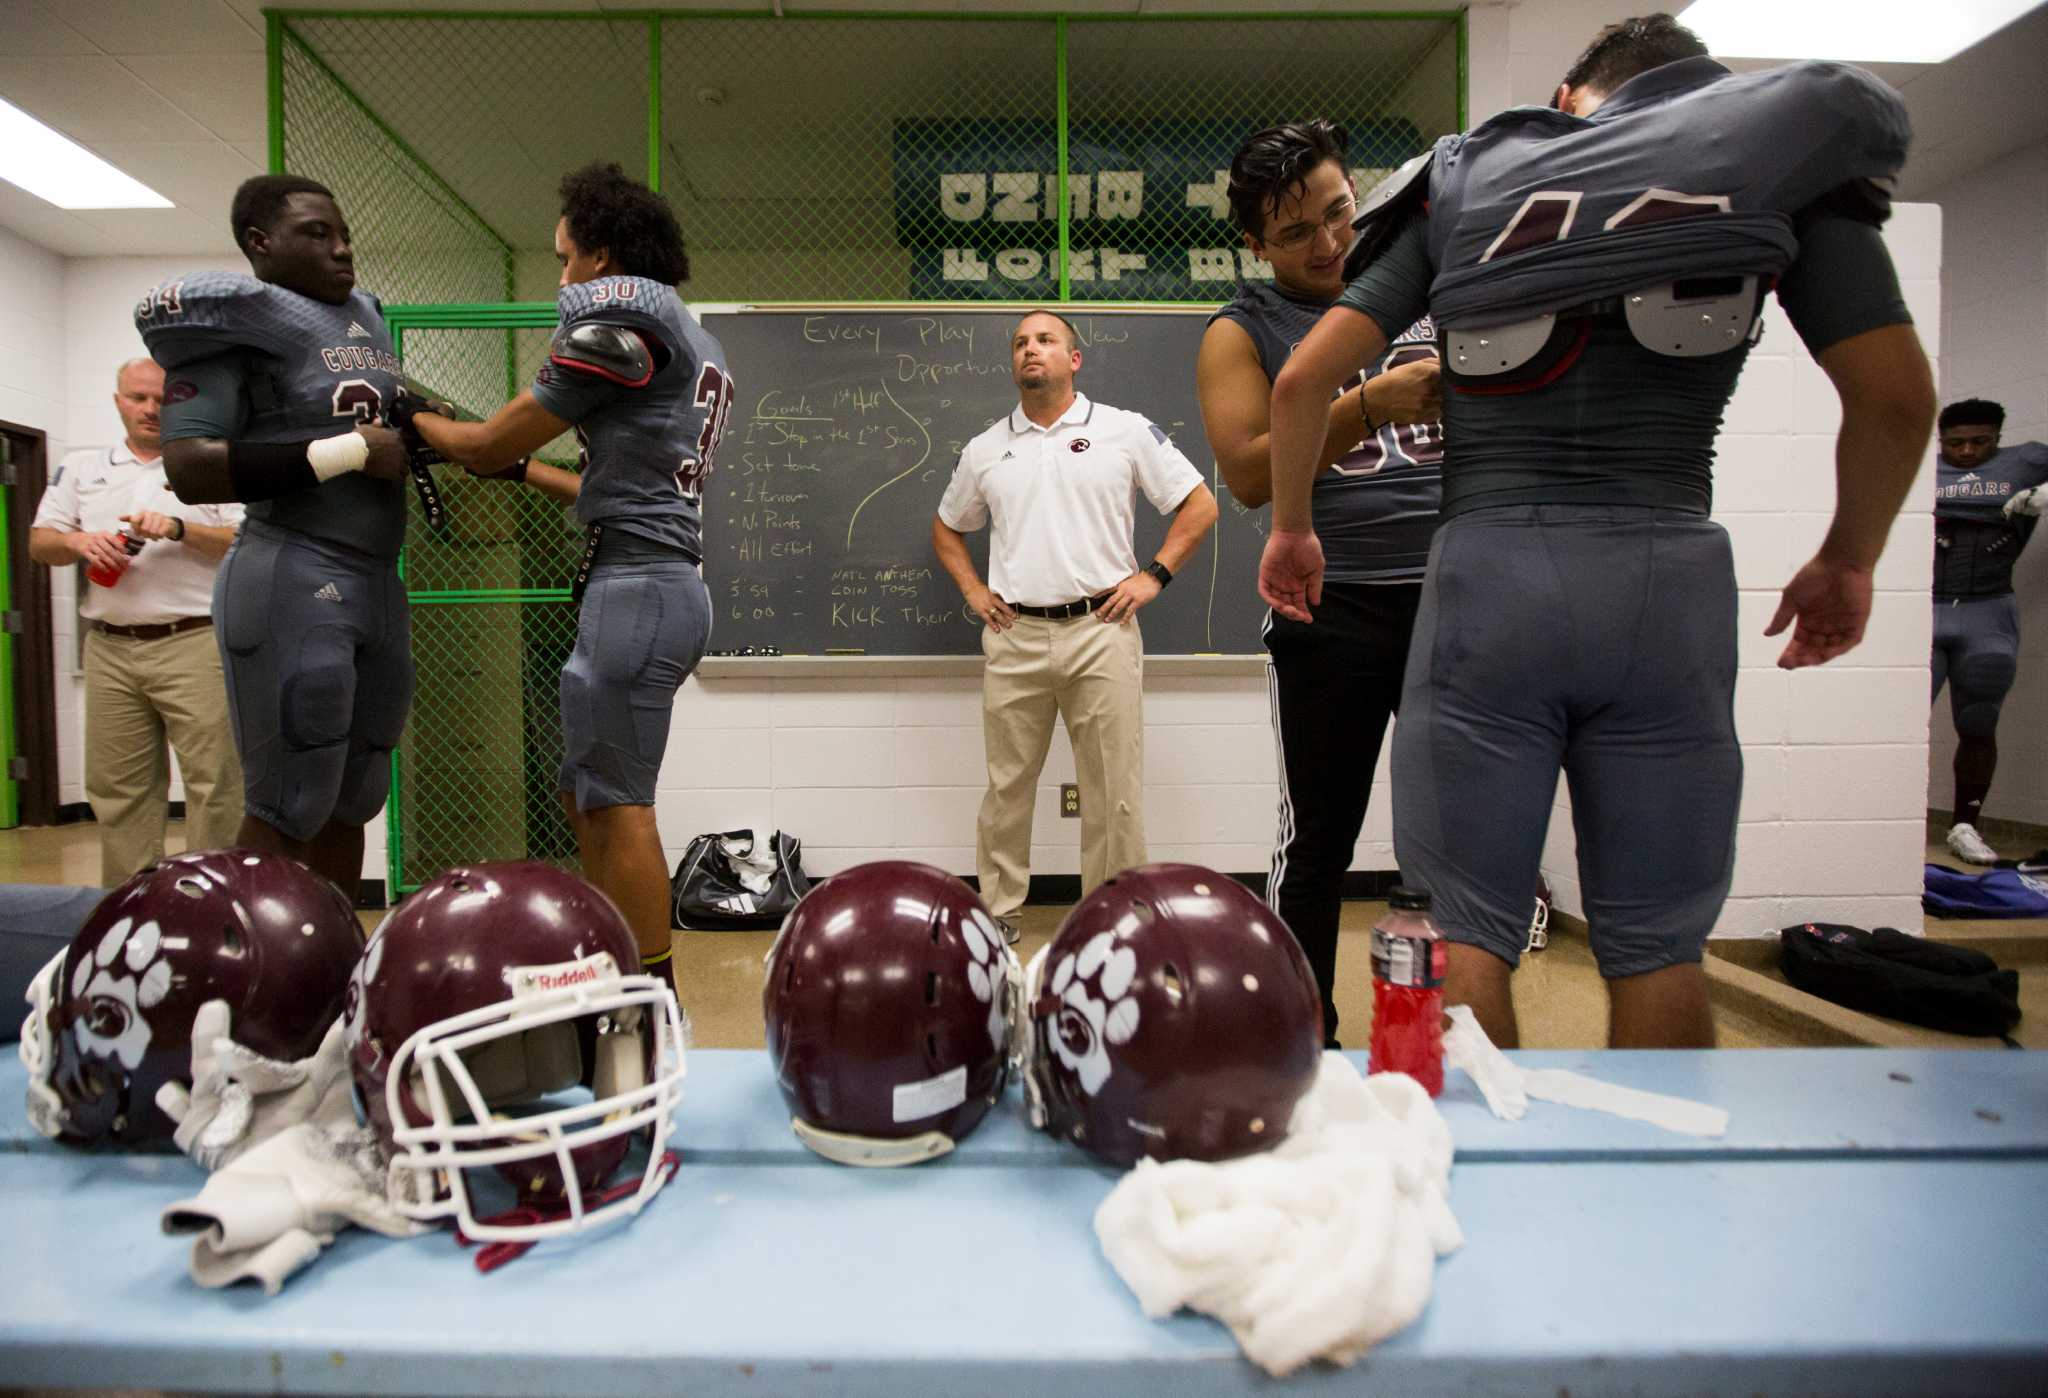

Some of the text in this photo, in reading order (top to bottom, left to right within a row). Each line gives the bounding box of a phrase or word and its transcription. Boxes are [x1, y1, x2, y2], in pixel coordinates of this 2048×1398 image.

[803, 316, 881, 353] Every
[904, 317, 976, 352] Play
[1073, 322, 1129, 347] New
[897, 354, 1012, 386] Opportun
[757, 391, 814, 418] Goals
[768, 421, 808, 448] Stop
[813, 433, 824, 441] in
[829, 427, 850, 442] the
[742, 452, 822, 476] Set tone
[1935, 481, 2012, 498] OUGARS
[763, 510, 801, 530] Points
[739, 536, 815, 561] All Effort
[875, 566, 933, 581] ANTHEM
[832, 585, 867, 597] COIN
[880, 584, 918, 598] TOSS
[832, 602, 885, 628] KICK
[901, 605, 953, 626] Their
[539, 966, 597, 990] Riddell
